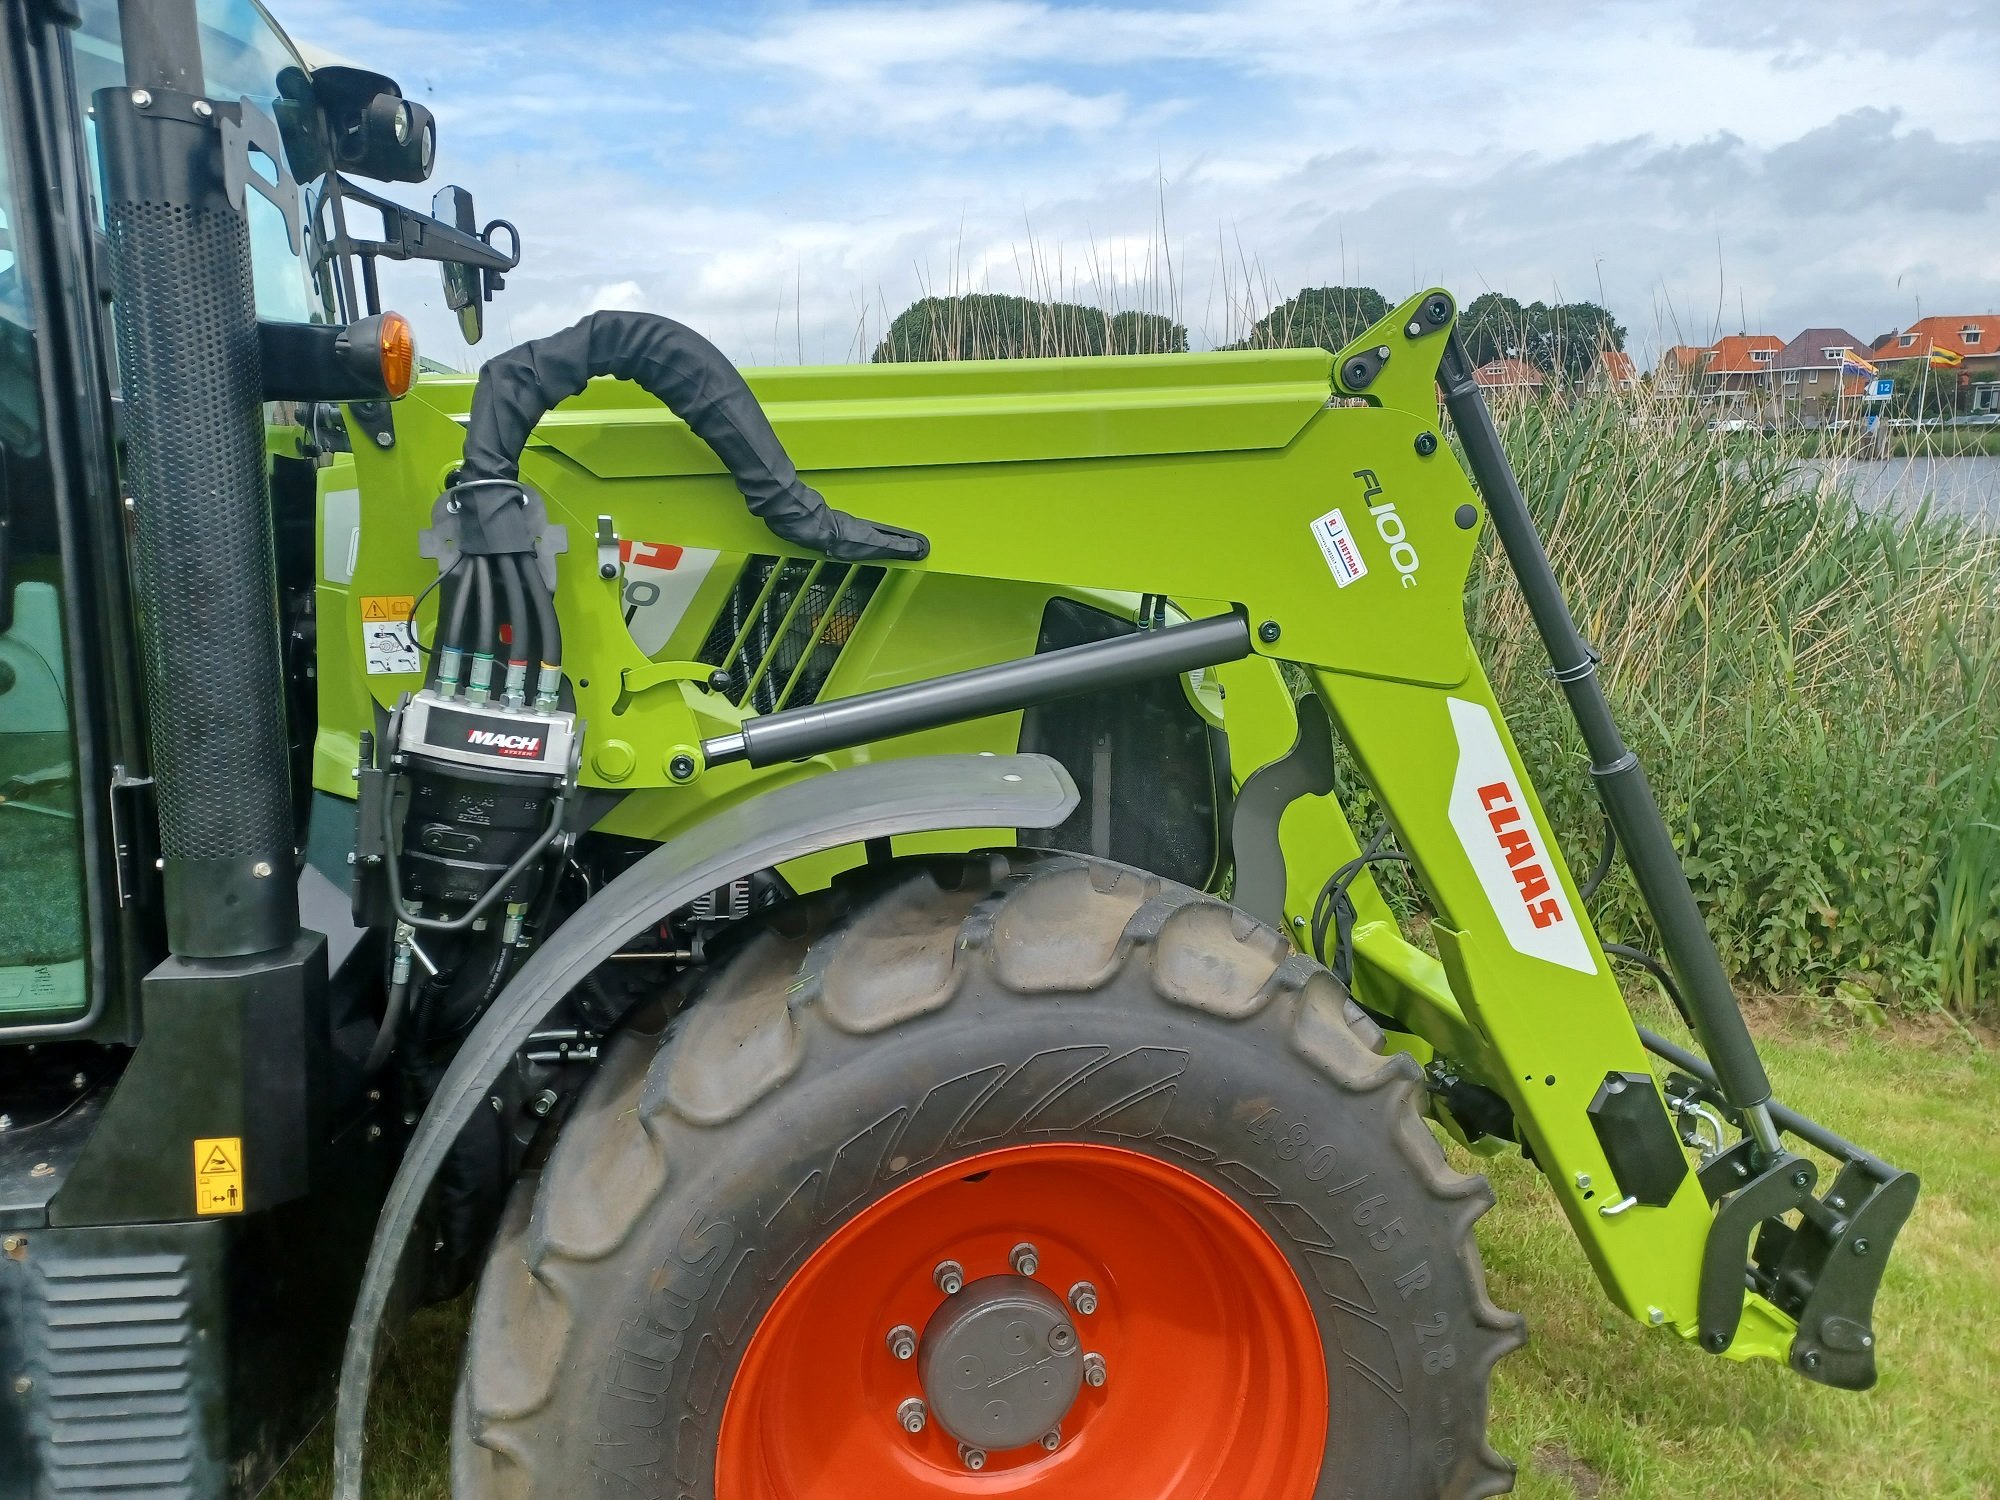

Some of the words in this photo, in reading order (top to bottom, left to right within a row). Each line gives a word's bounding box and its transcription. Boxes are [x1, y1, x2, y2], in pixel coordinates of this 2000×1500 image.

[1880, 383, 1890, 392] 12
[1337, 538, 1359, 576] RIETMAN
[468, 730, 539, 751] MACH
[503, 749, 533, 757] SYSTEM
[1477, 782, 1563, 929] CLAAS
[1393, 1260, 1432, 1303] R
[1413, 1311, 1457, 1375] 28
